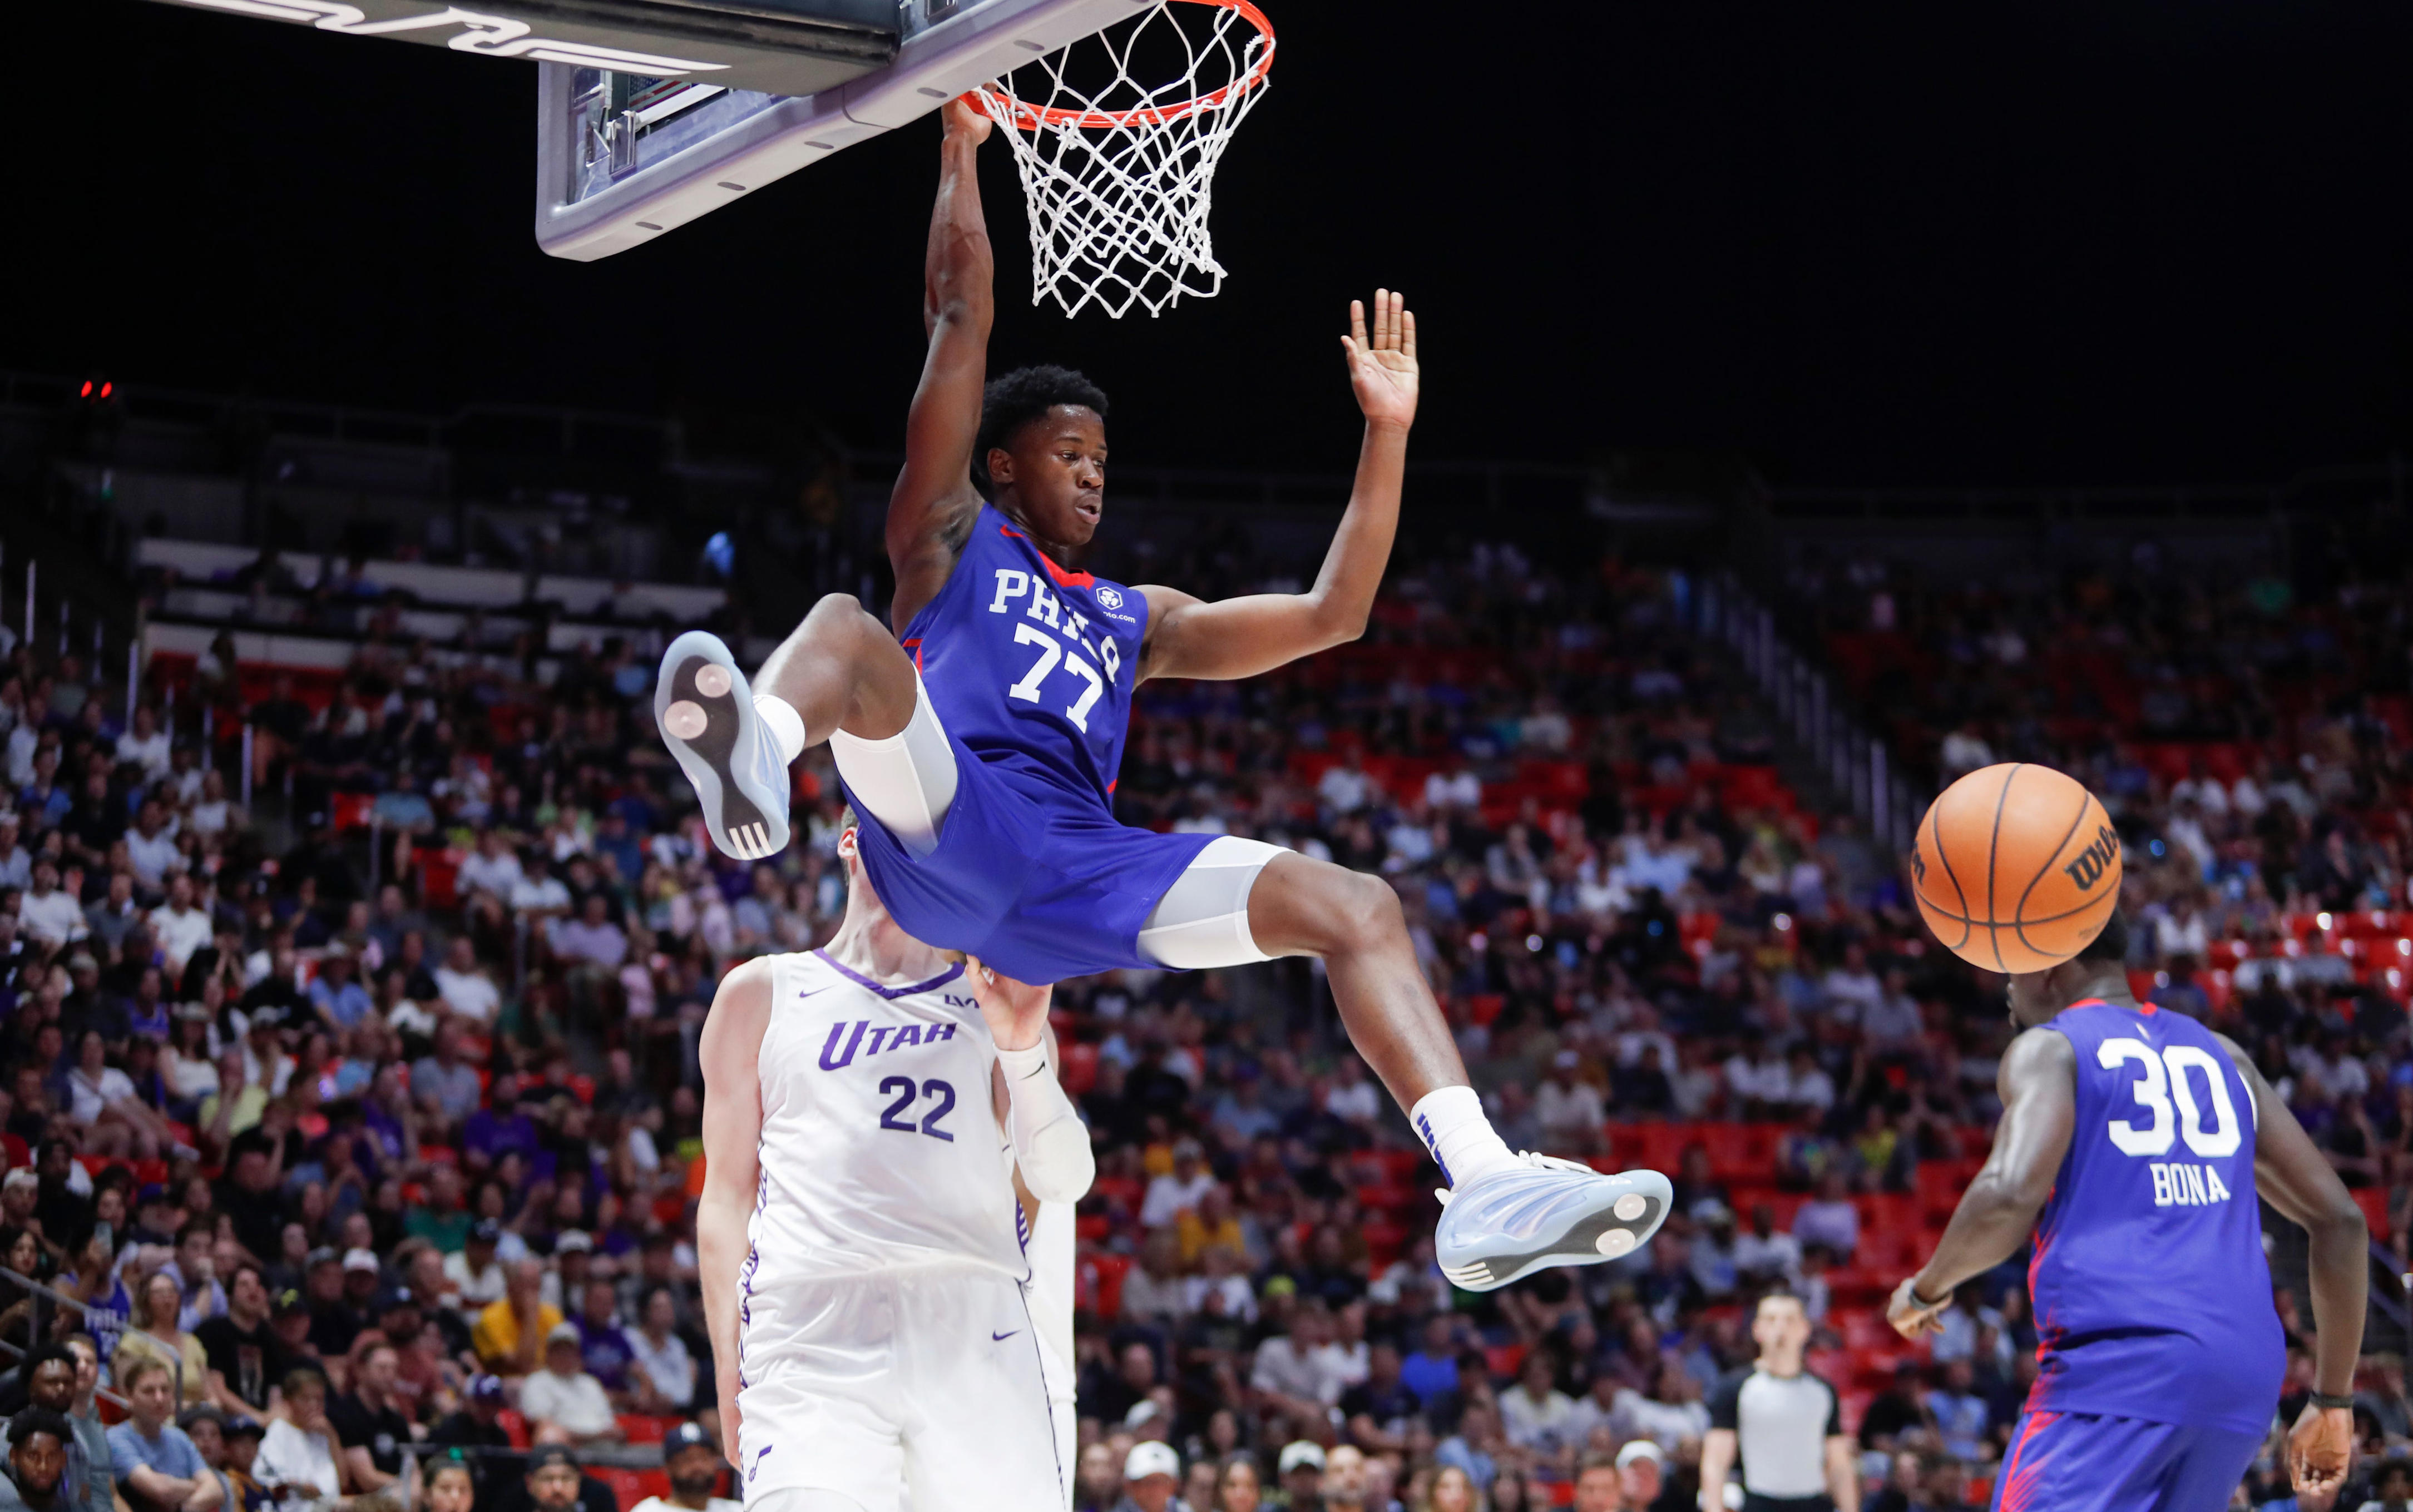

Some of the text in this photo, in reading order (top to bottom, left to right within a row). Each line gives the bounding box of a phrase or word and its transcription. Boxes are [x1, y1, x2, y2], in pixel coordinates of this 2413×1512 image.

[1009, 622, 1103, 734] 77
[818, 1020, 957, 1071] UTAH
[879, 1076, 956, 1143] 22
[2096, 1038, 2242, 1158] 30
[2149, 1163, 2231, 1206] BONA
